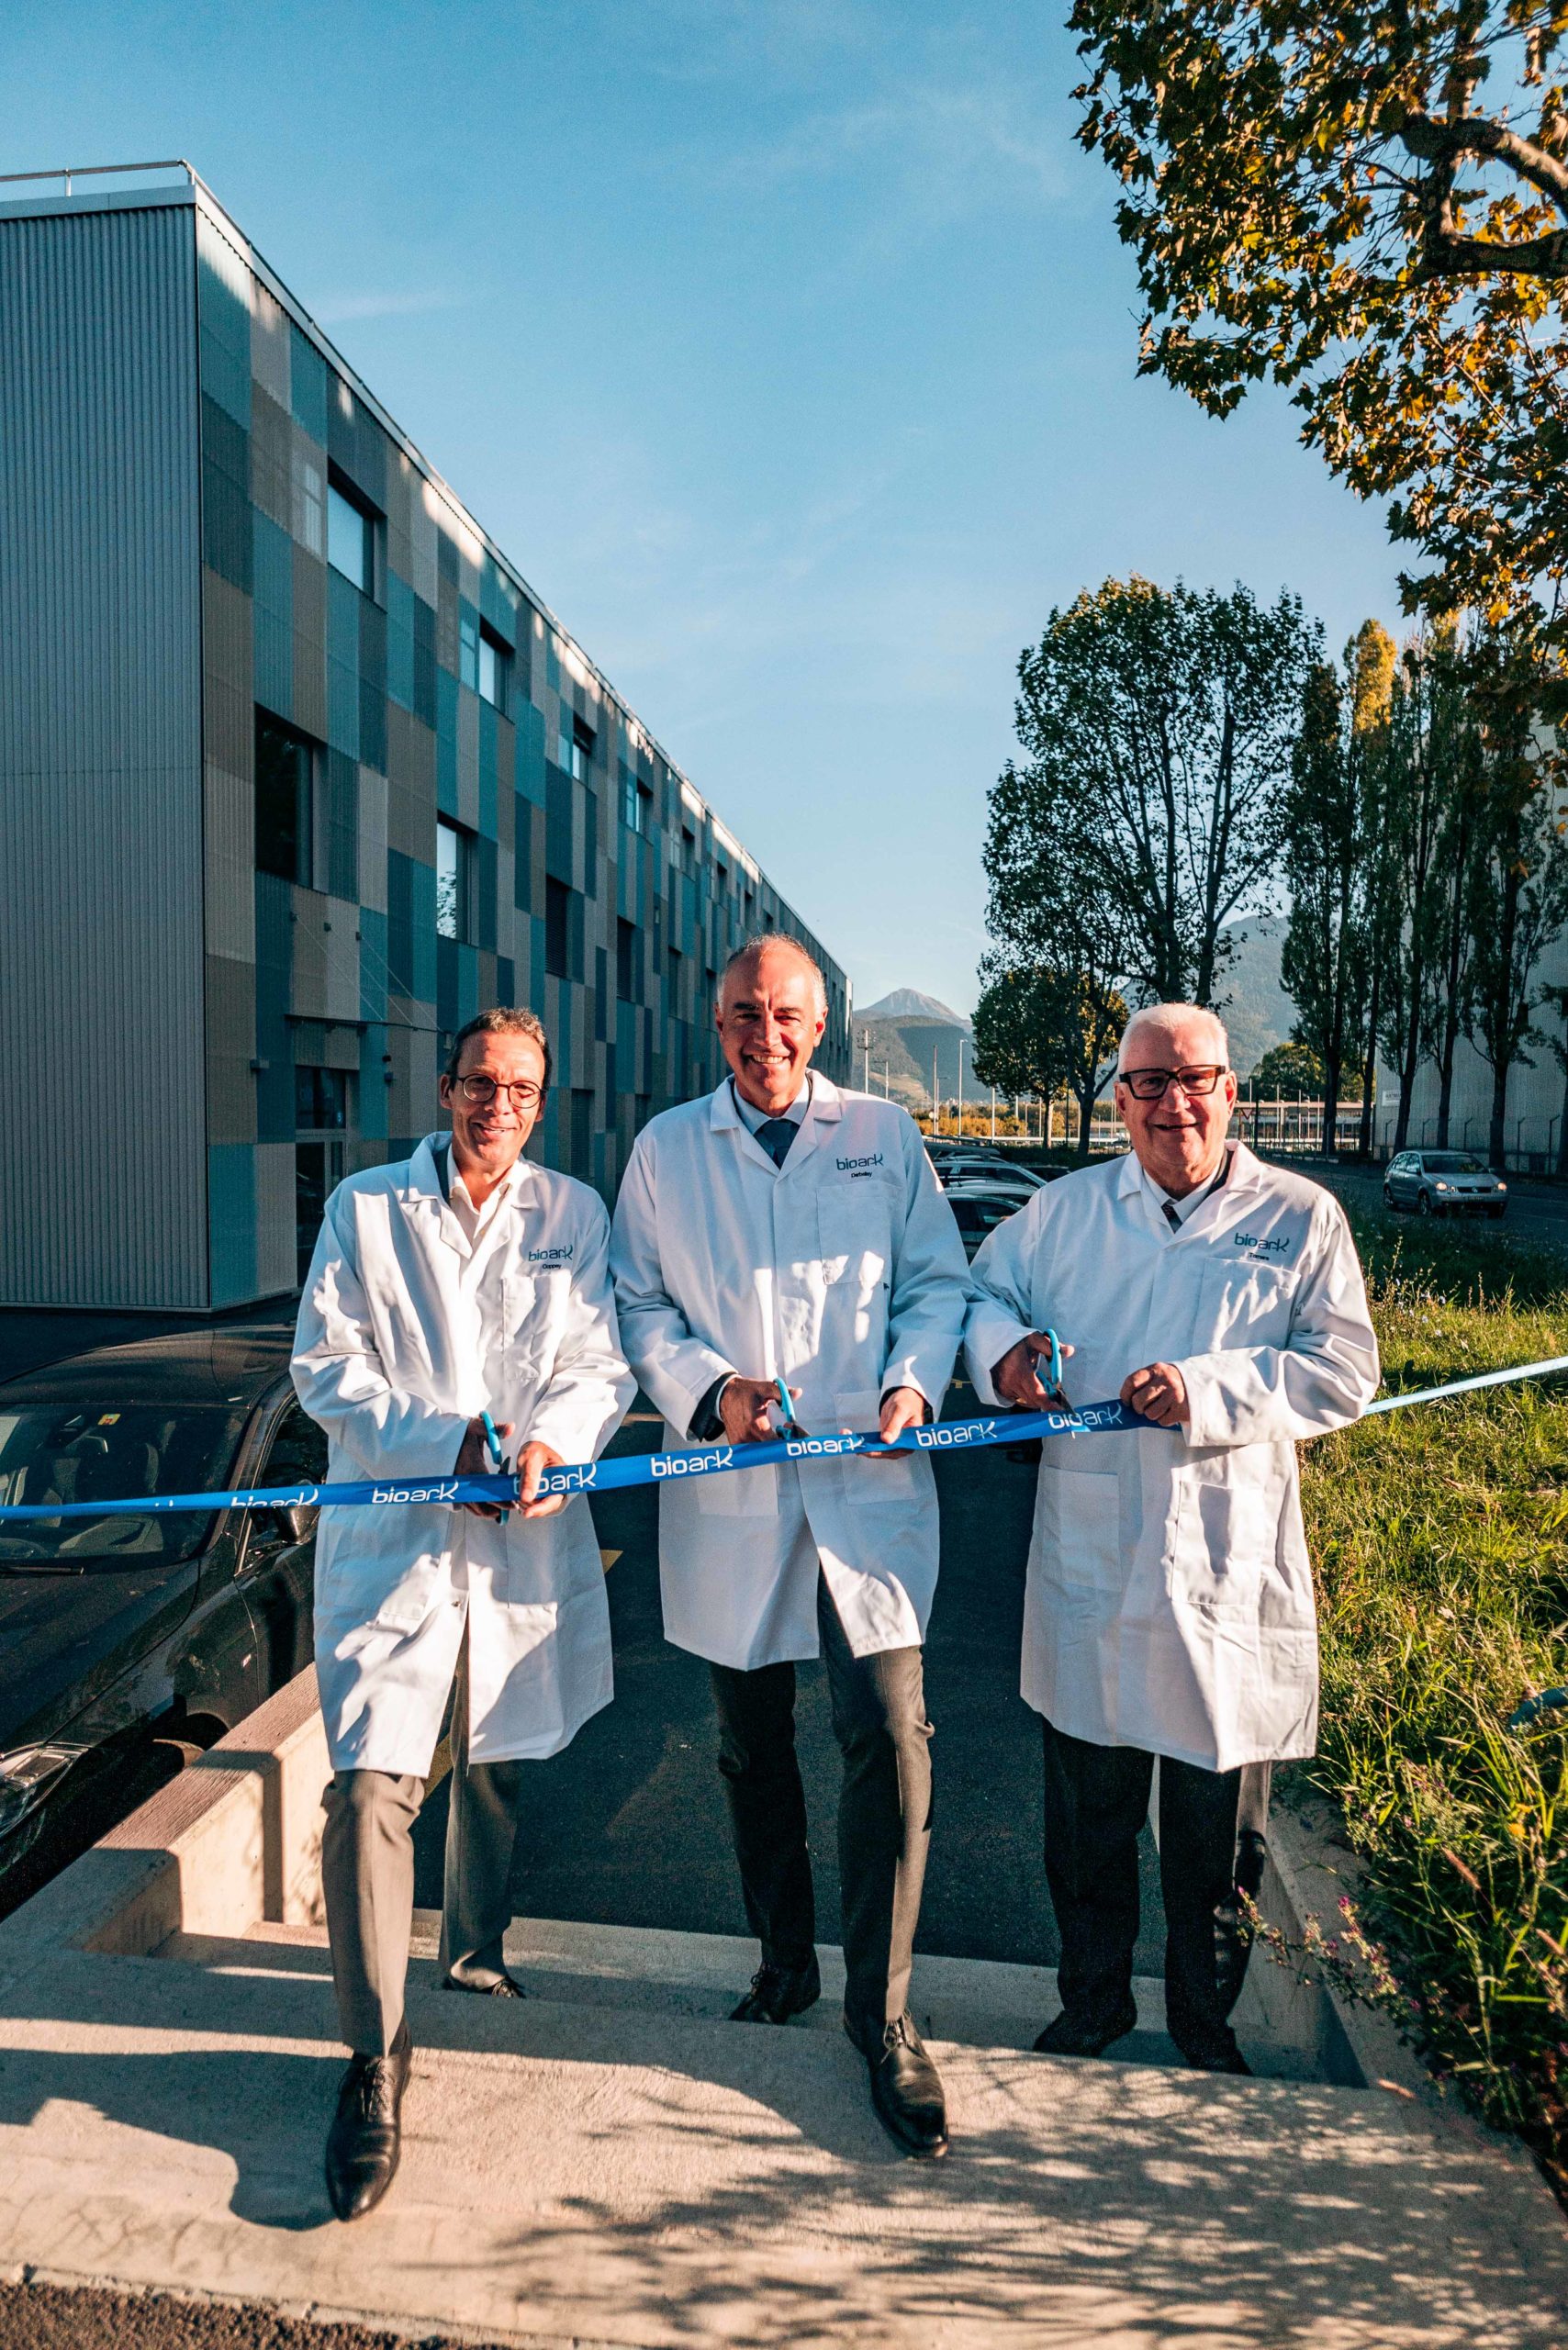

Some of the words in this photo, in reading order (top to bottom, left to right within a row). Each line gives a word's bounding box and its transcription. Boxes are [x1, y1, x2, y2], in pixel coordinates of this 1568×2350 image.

[836, 1153, 884, 1170] bioark
[1235, 1232, 1290, 1252] bioark
[529, 1244, 573, 1261] bioark
[371, 1481, 460, 1504] bioark
[650, 1445, 734, 1478] bioark
[787, 1435, 866, 1457] bioark
[915, 1419, 998, 1447] bioark
[1048, 1404, 1124, 1428] bioark
